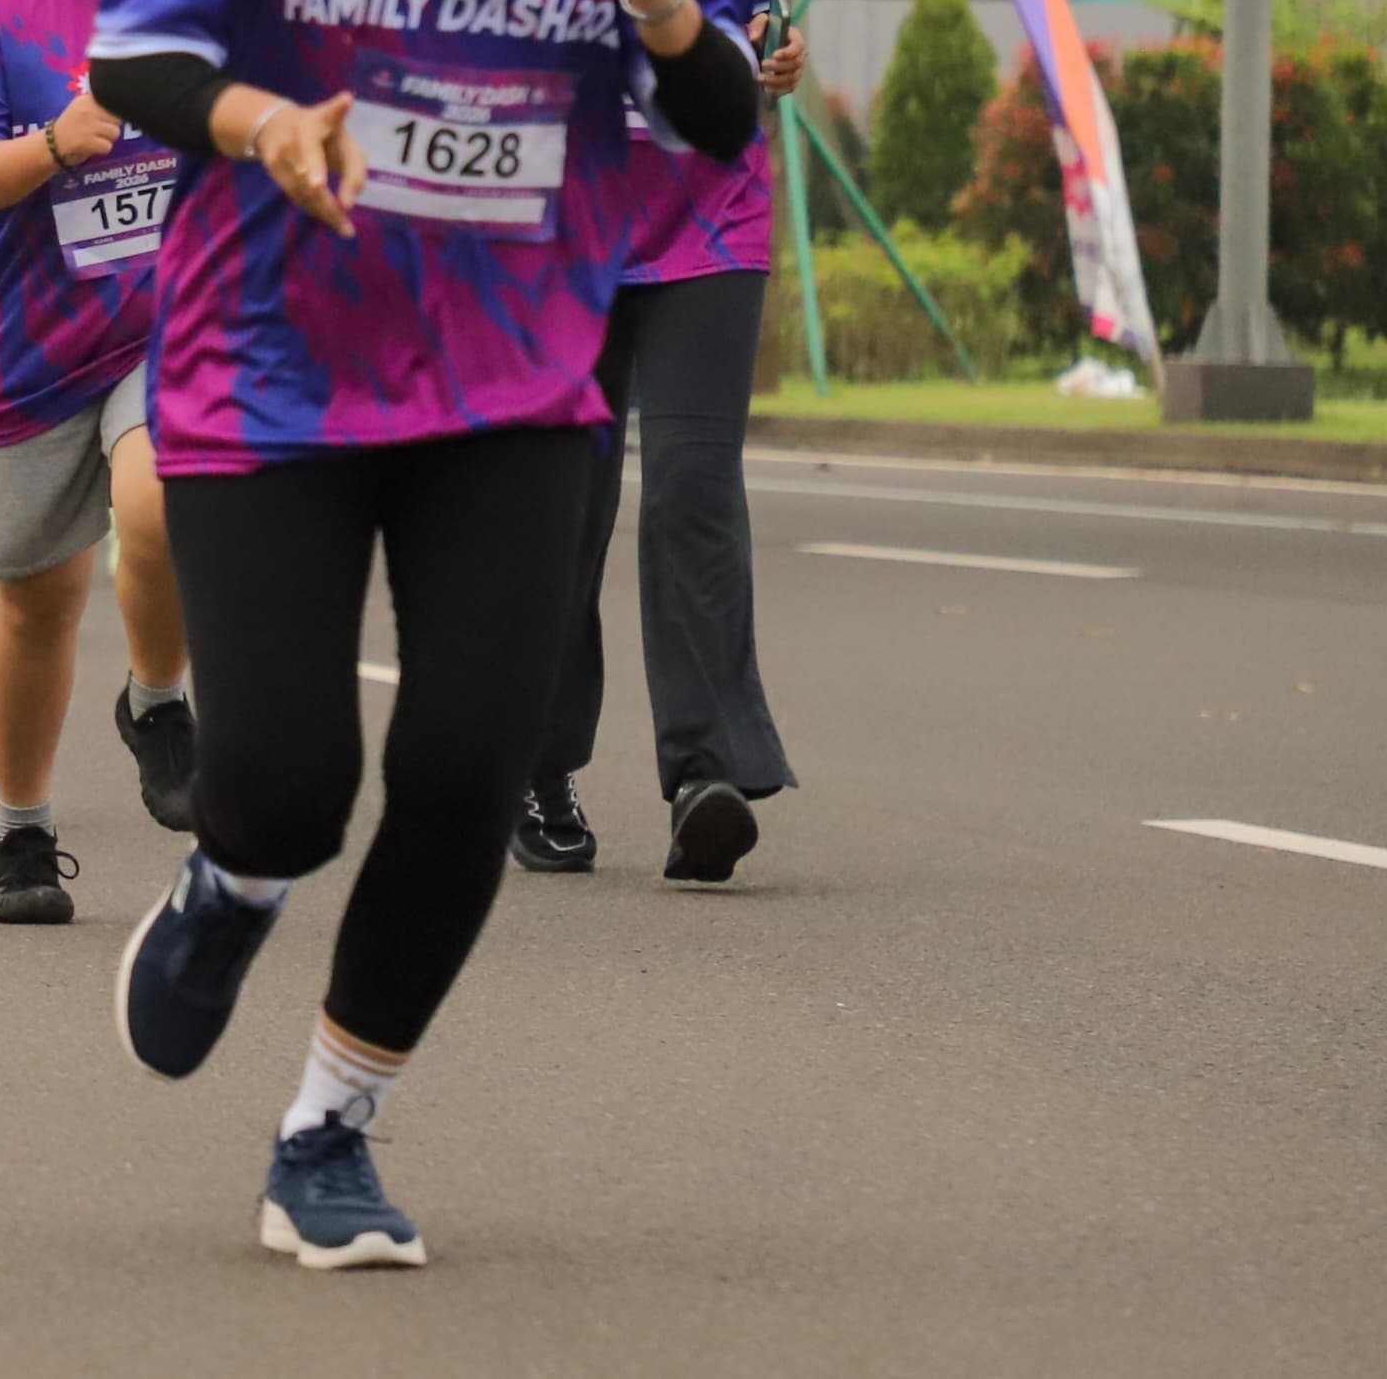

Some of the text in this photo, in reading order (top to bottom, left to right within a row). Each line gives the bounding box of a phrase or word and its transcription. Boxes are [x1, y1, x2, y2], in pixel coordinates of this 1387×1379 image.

[83, 157, 177, 186] FAMILY DASH
[394, 120, 521, 179] 1628
